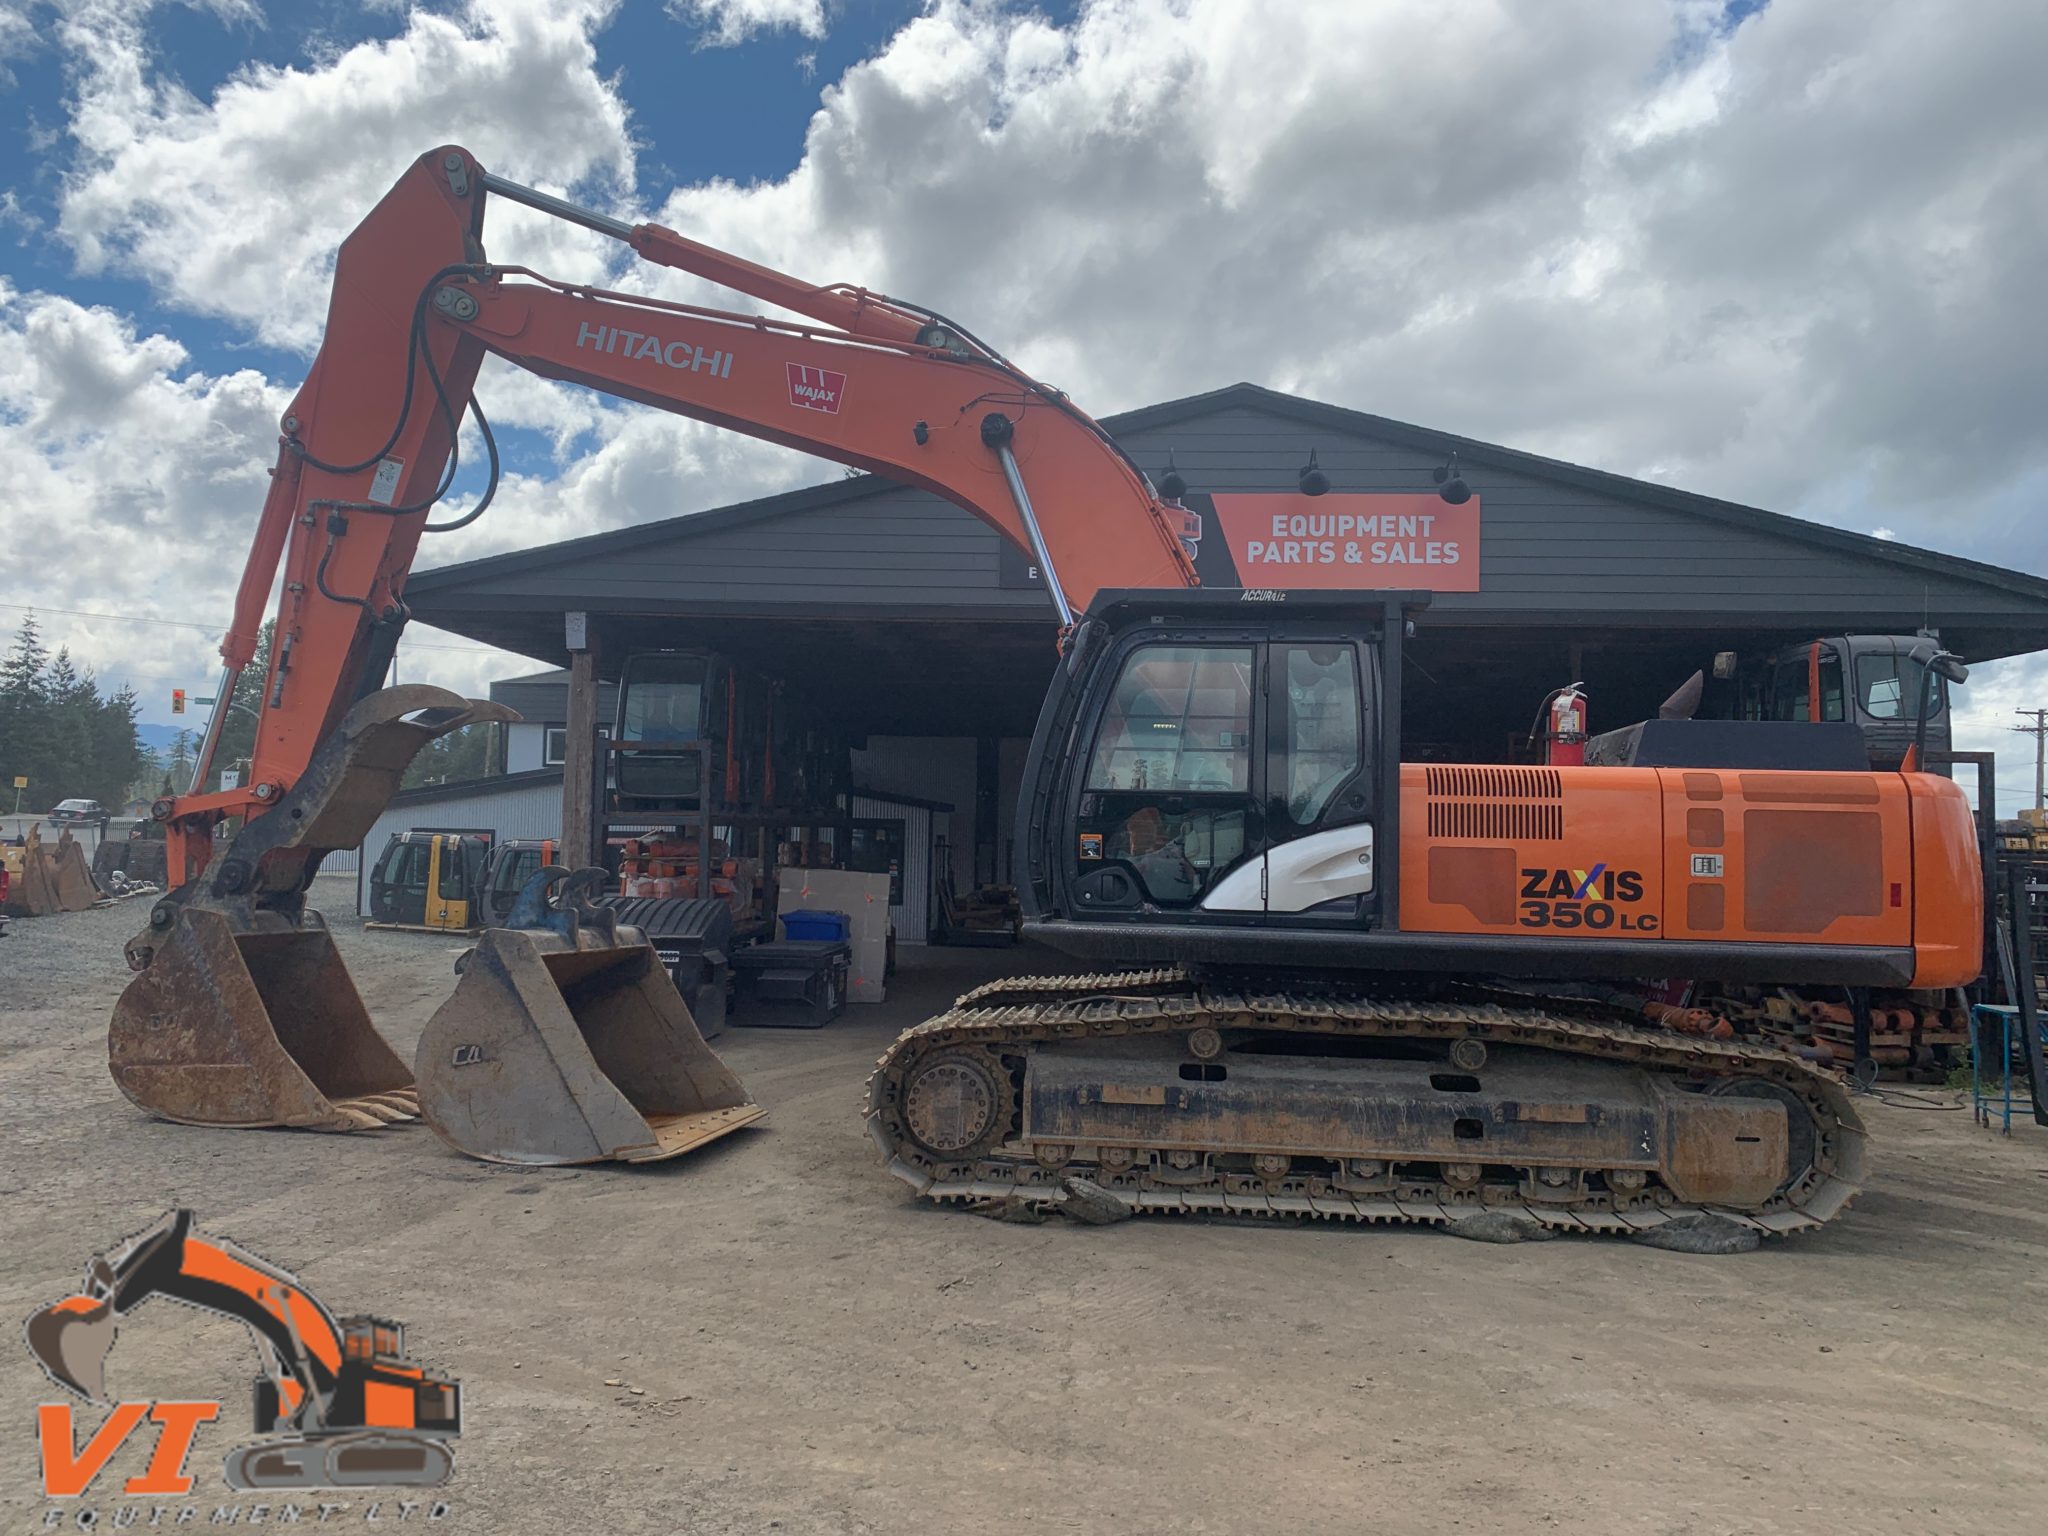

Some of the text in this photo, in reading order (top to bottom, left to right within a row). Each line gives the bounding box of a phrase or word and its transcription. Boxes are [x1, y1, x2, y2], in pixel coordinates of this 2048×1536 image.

[576, 321, 734, 379] HITACHI
[794, 383, 836, 403] WAJAX
[1272, 515, 1435, 538] EQUIPMENT
[1247, 541, 1460, 565] PARTS & SALES
[1520, 863, 1644, 902] ZAXIS
[1519, 901, 1659, 931] 350 LC
